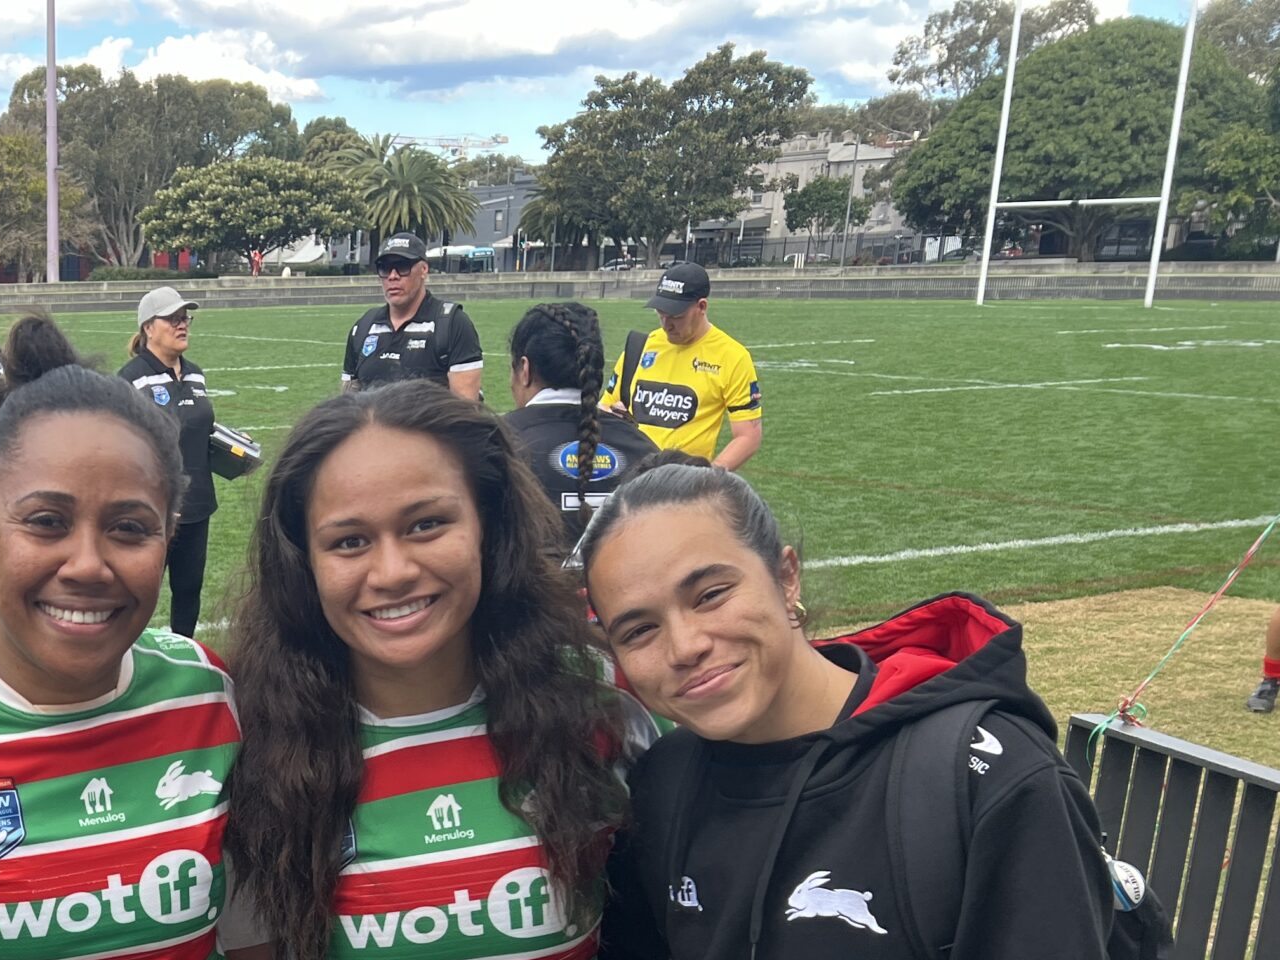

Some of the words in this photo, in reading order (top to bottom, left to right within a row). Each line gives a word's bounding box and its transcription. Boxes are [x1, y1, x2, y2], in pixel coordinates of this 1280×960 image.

[634, 385, 693, 410] brydens
[649, 406, 689, 422] lawyers
[79, 811, 126, 827] Menulog
[424, 828, 475, 844] Menulog
